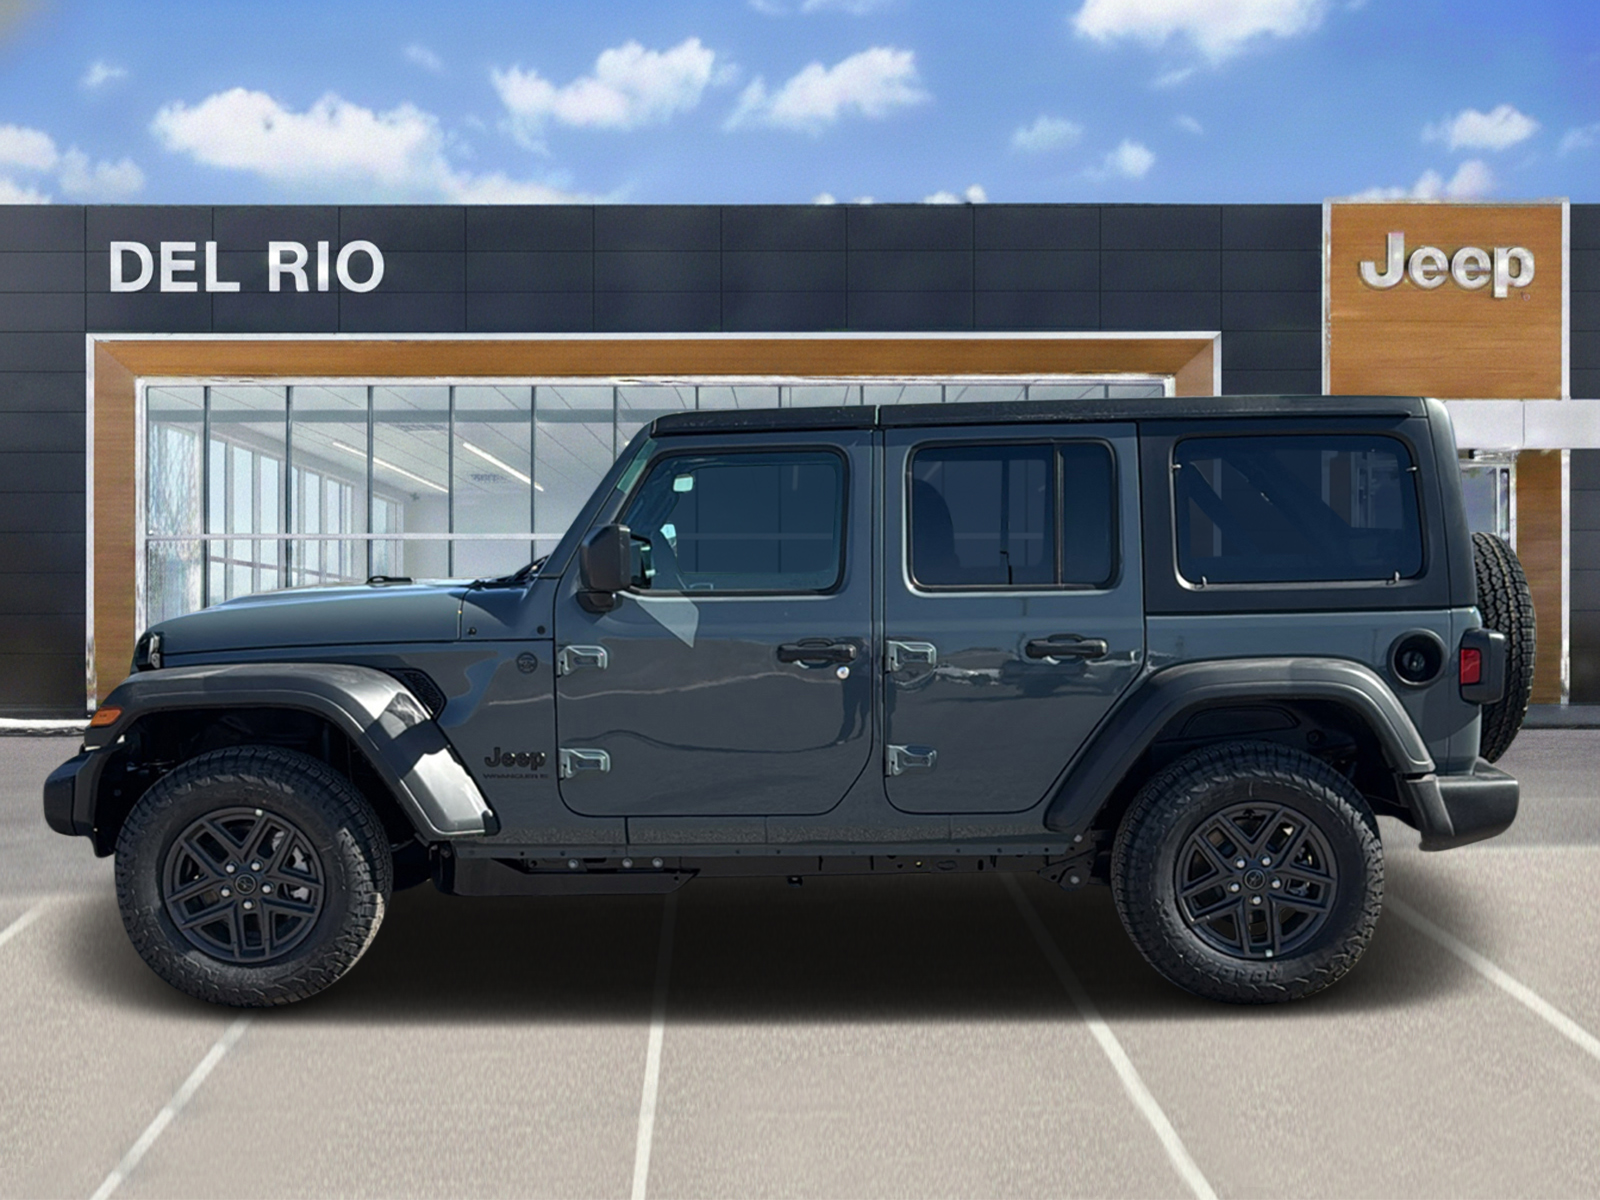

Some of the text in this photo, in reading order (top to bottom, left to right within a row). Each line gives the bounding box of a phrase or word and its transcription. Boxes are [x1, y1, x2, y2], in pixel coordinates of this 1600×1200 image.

[110, 240, 385, 293] DEL RIO
[1359, 231, 1535, 299] Jeep
[484, 746, 547, 771] Jeep
